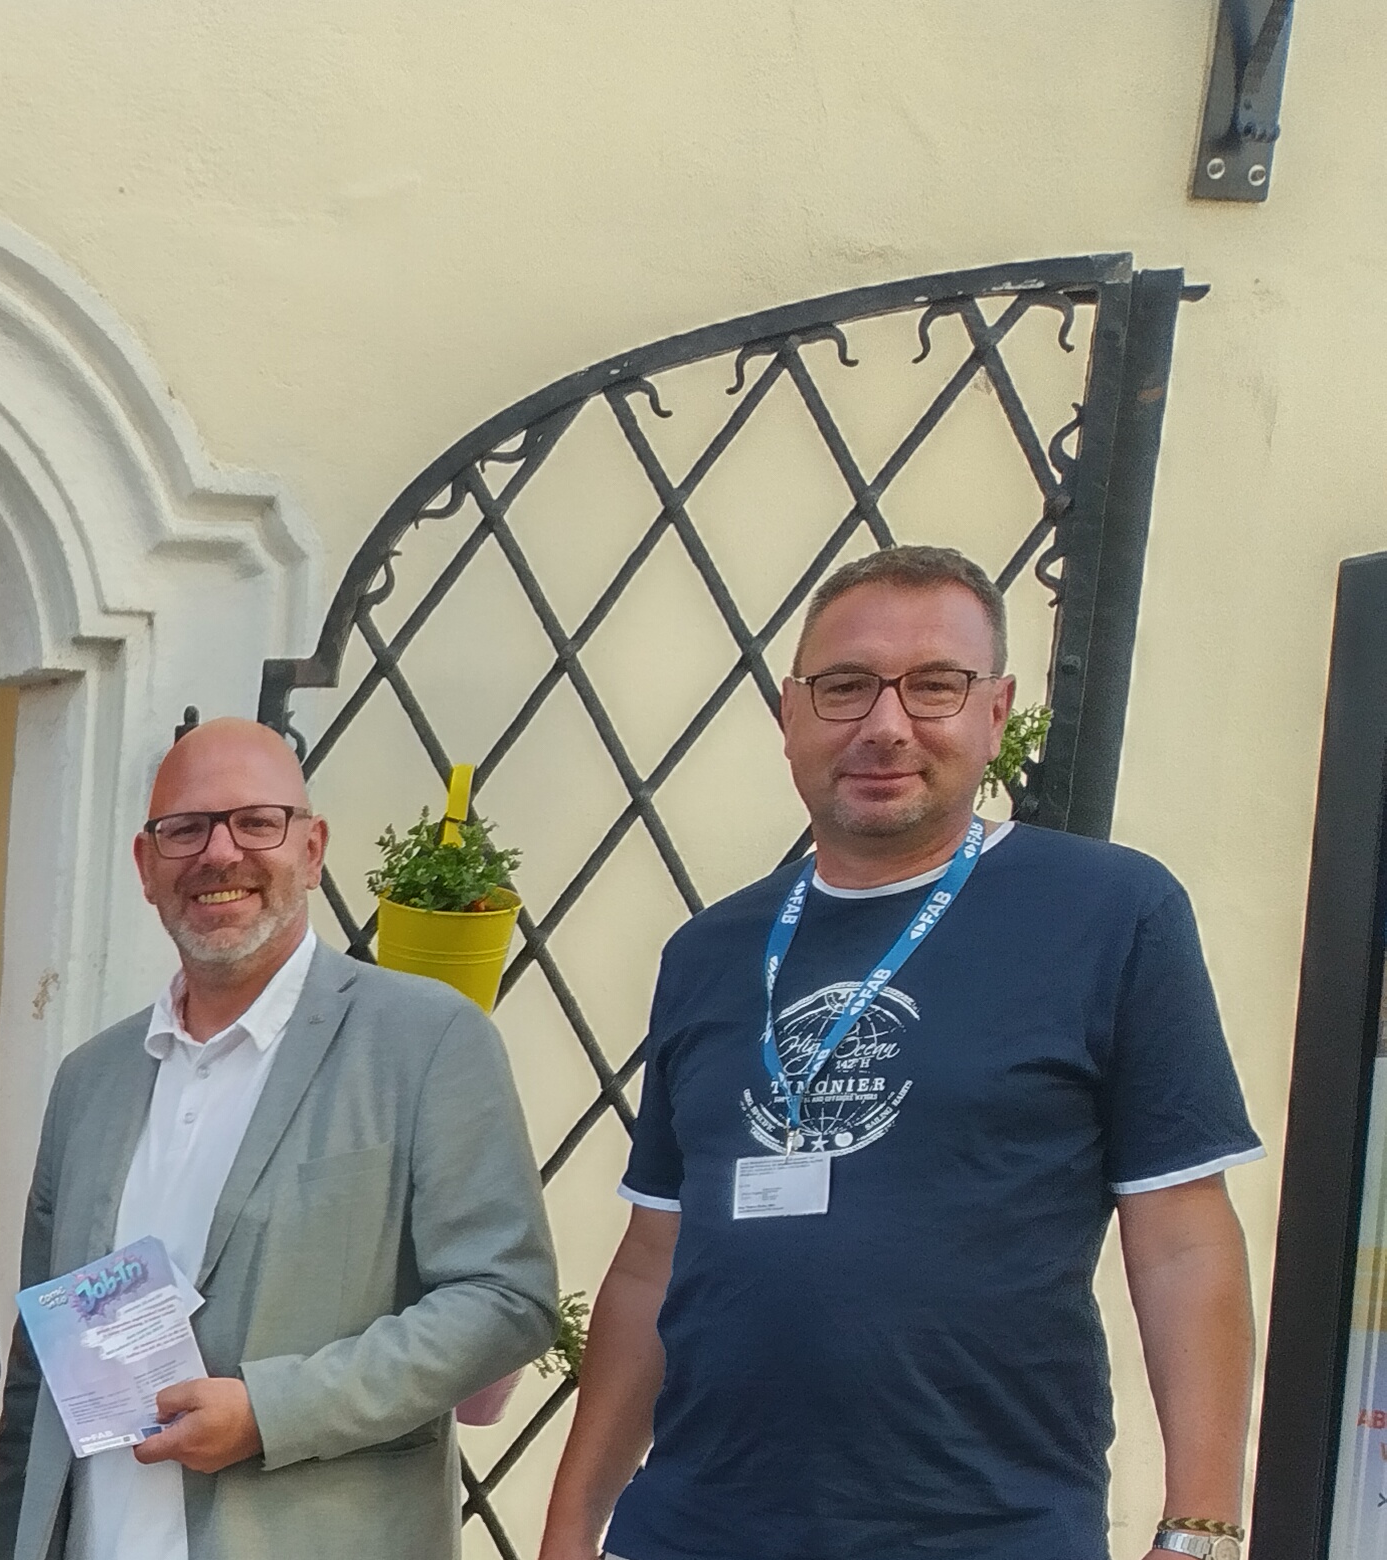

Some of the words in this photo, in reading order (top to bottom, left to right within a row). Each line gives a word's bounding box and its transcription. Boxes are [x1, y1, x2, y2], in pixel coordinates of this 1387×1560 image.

[966, 821, 984, 846] FAB
[780, 898, 805, 925] FAB
[918, 891, 952, 925] FAB
[860, 967, 892, 1005] FAB
[832, 1036, 900, 1060] Ocean
[864, 1105, 893, 1131] SAILING
[891, 1079, 914, 1107] HABITS
[75, 1259, 143, 1313] Job-In
